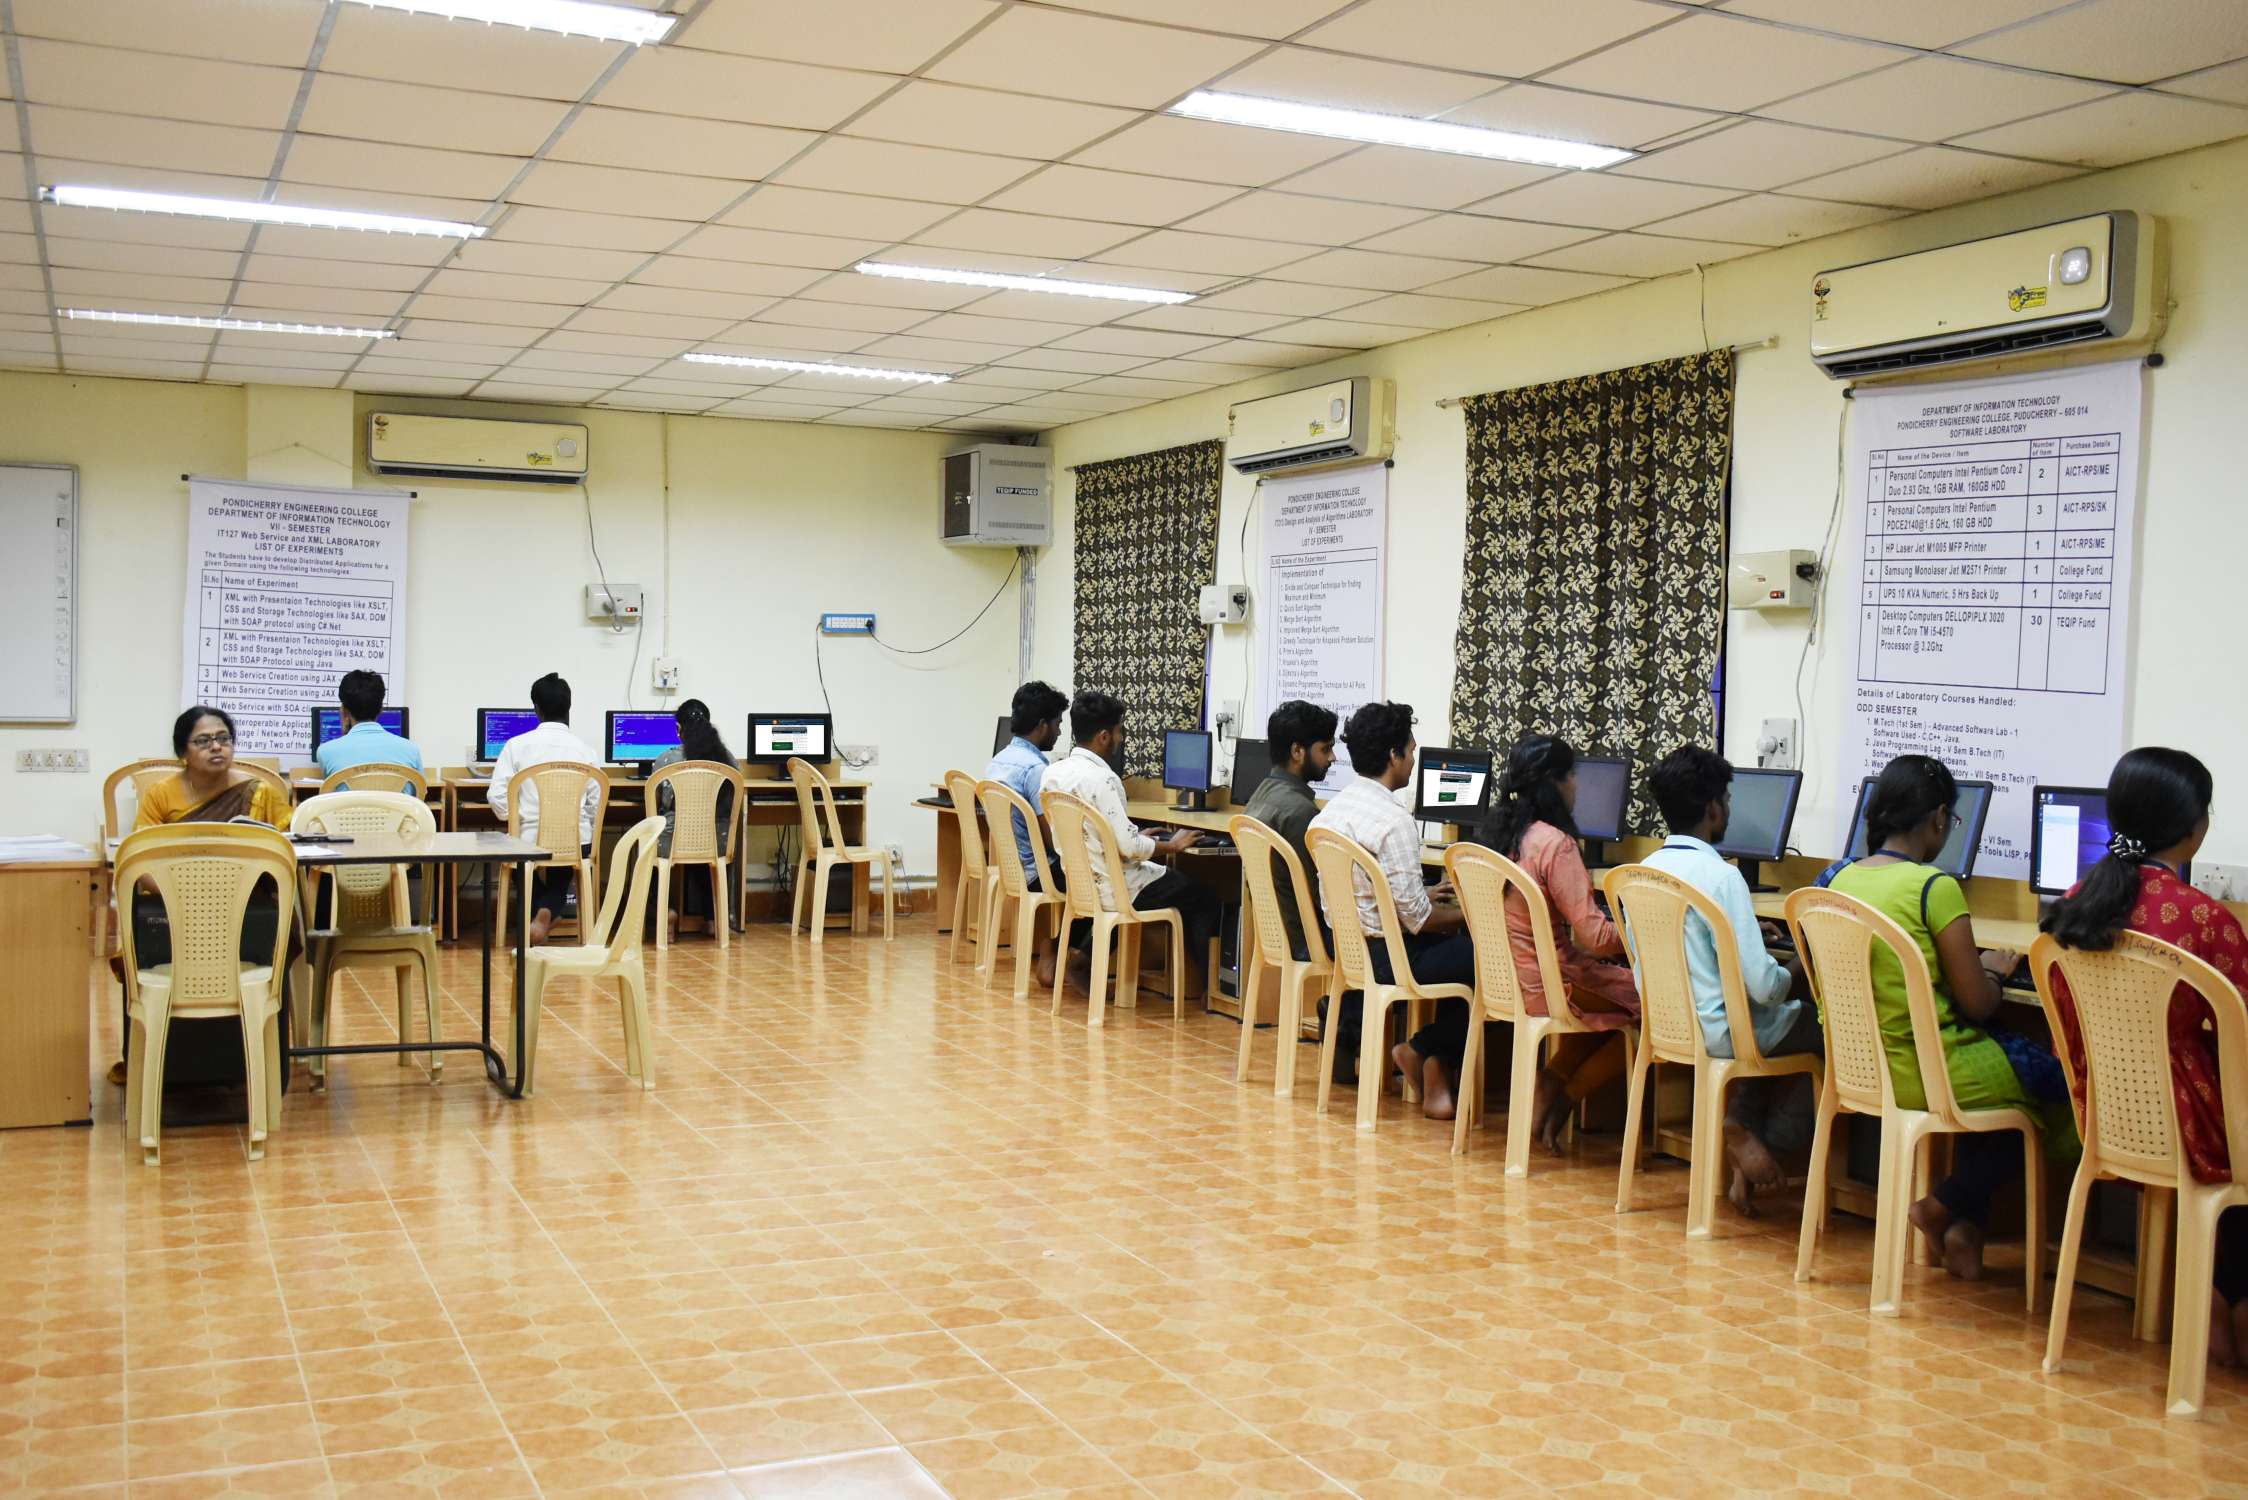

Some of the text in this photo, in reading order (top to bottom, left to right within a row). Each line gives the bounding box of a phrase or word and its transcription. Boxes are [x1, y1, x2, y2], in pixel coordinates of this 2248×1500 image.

[1922, 395, 2060, 416] DEPARTMENT OF INFORMATION TECHNOLOGY
[1897, 417, 1938, 430] PONDICHERRY
[1940, 414, 1980, 427] ENGINEERING
[1982, 412, 2012, 424] COLLEGE,
[2014, 408, 2057, 421] PUDUCHERRY
[2075, 406, 2088, 415] 014
[1950, 424, 2026, 439] SOFTWARE LABORATORY
[1889, 464, 2022, 481] Personal Computers Intel Pentium Core 2
[2039, 469, 2044, 478] 2
[1889, 480, 2005, 495] Duo 2.93 Ghz, 1GB RAM, 160GB HDD
[223, 498, 378, 517] PONDICHERRY ENGINEERING COLLEGE
[1888, 502, 1996, 516] Personal Computers Intel Pentium
[2037, 505, 2042, 514] 3
[208, 508, 391, 528] DEPARTMENT OF INFORMATION TECHNOLOGY
[1953, 518, 1963, 527] 160
[1966, 518, 1976, 527] GB
[1978, 517, 1992, 527] HDD
[288, 524, 330, 533] SEMESTER
[218, 530, 380, 548] IT127 Web Service and XML LABORATORY
[255, 543, 343, 556] LIST OF EXPERIMENTS
[1886, 542, 1986, 553] HP Laser Jet M1005 MFP Printer
[2036, 541, 2039, 550] 1
[219, 552, 246, 560] Students
[273, 556, 297, 564] develop
[299, 558, 333, 566] Distributed
[336, 560, 373, 568] Applications
[1884, 565, 2006, 577] Samsung Monolaser Jet M2571 Printer
[2060, 565, 2103, 577] College Fund
[225, 577, 298, 589] Name of Experiment
[1884, 589, 1895, 599] UPS
[1898, 589, 1904, 599] 10
[1907, 589, 1920, 599] KVA
[1952, 590, 1956, 599] 5
[1959, 590, 1969, 599] Hrs
[1972, 590, 1988, 599] Back
[1990, 590, 1998, 601] Up
[2058, 590, 2101, 601] College Fund
[225, 593, 388, 610] XML with Presentaion Technologies like XSLT,
[225, 605, 385, 621] CSS and Storage Technologies like SAX, DOM
[1882, 610, 1907, 622] Desktop
[1909, 611, 1943, 623] Computers
[1989, 612, 2004, 622] 3020
[224, 617, 239, 625] with
[242, 617, 261, 625] SOAP
[264, 619, 294, 628] protocol
[297, 622, 315, 631] using
[2031, 616, 2042, 625] 30
[2057, 617, 2095, 628] TEQIP Fund
[1881, 625, 1895, 635] Intel
[1897, 626, 1901, 635] R
[1903, 626, 1917, 636] Core
[1918, 626, 1928, 636] TM
[1881, 640, 1911, 651] Processor
[240, 656, 260, 664] SOAP
[263, 657, 293, 665] Protocol
[295, 660, 314, 668] using
[317, 660, 332, 668] Java
[205, 669, 209, 677] 3
[240, 671, 266, 680] Service
[269, 673, 298, 681] Creation
[301, 675, 320, 683] using
[323, 675, 336, 683] JAX
[1858, 688, 1883, 698] Details
[1887, 690, 1893, 698] of
[1896, 691, 1938, 704] Laboratory
[1942, 694, 1975, 704] Courses
[1857, 704, 1917, 715] ODD SEMESTER
